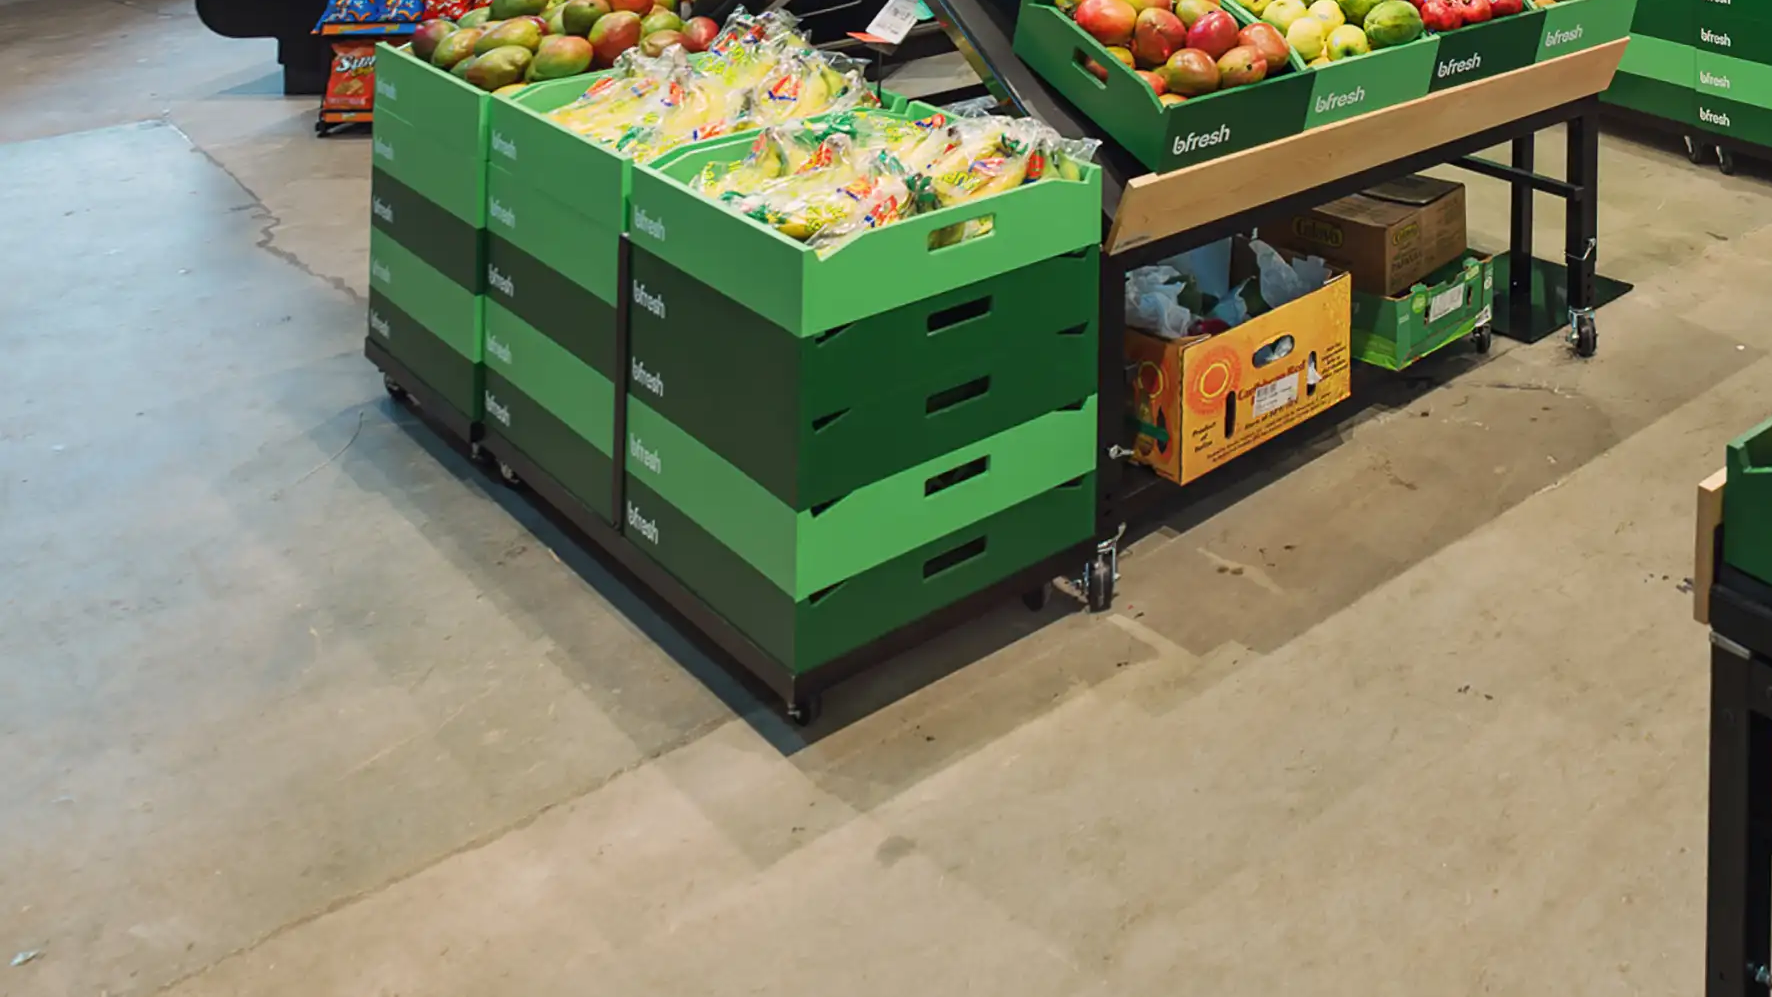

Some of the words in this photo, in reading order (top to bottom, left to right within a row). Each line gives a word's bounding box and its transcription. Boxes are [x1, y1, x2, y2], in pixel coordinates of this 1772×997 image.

[1544, 24, 1583, 48] bfresh
[1700, 28, 1731, 47] bfresh
[1437, 53, 1482, 78] bfresh
[1699, 71, 1730, 89] bfresh
[1314, 85, 1366, 113] bfresh
[1699, 107, 1730, 127] bfresh
[1172, 123, 1231, 156] bfresh
[634, 203, 666, 242] bfresh
[488, 263, 514, 298] bfresh
[632, 279, 665, 320] bfresh
[631, 356, 664, 398] bfresh
[629, 432, 662, 475] bfresh
[627, 501, 659, 546] bfresh
